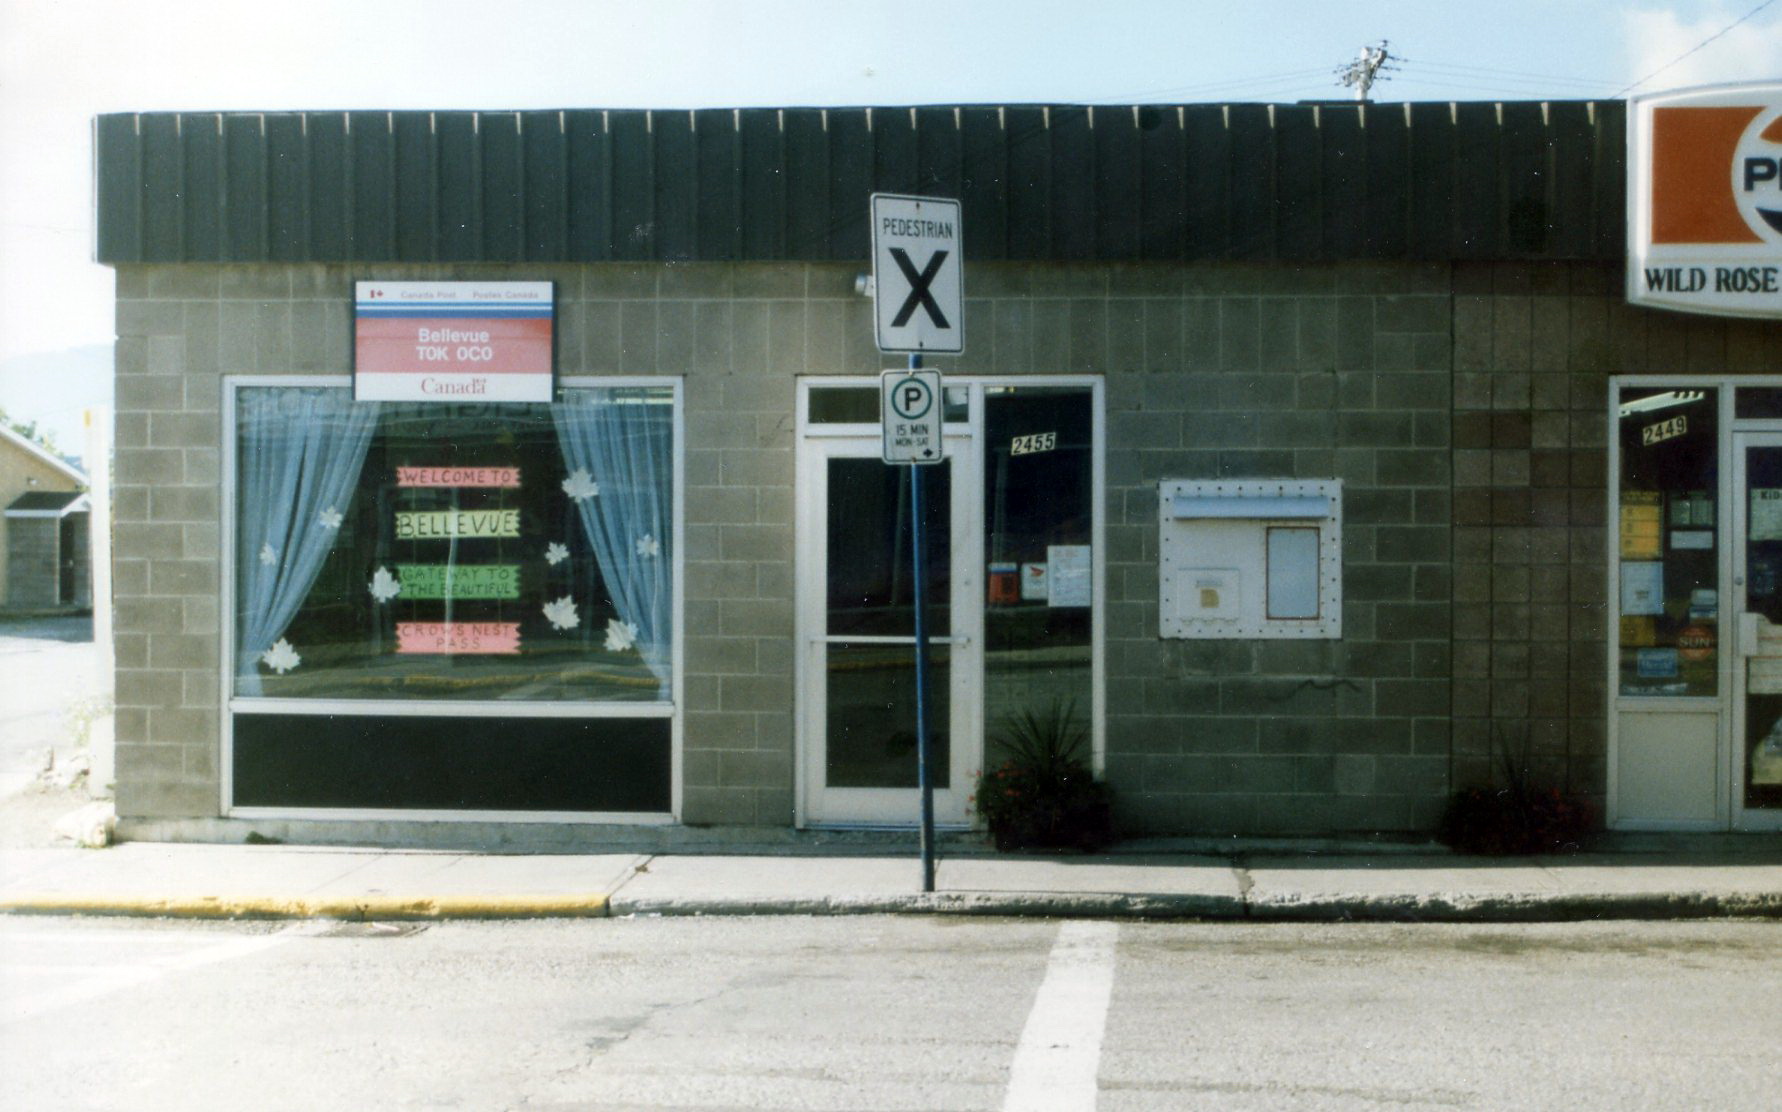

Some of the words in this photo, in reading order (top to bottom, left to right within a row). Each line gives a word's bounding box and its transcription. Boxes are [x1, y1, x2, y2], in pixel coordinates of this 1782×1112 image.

[1744, 157, 1782, 191] P
[883, 217, 953, 239] PEDESTRIAN
[888, 247, 951, 329] X
[1644, 267, 1706, 293] WILD
[1715, 267, 1779, 293] ROSE
[400, 290, 434, 299] Canada
[437, 290, 456, 299] Post
[472, 290, 500, 299] Postes
[505, 290, 539, 299] Canada
[418, 327, 490, 343] Bellevue
[420, 377, 487, 395] Canada
[903, 387, 922, 411] P
[896, 424, 907, 436] 15
[910, 424, 928, 435] MIN
[1645, 416, 1686, 444] 2449
[1014, 434, 1054, 453] 2455
[404, 470, 485, 483] WELCOME
[492, 470, 512, 482] TO
[400, 512, 515, 536] BELLEVUE
[487, 568, 509, 580] TO
[409, 583, 434, 595] THE
[441, 583, 512, 595] BEAUTIFUL
[436, 638, 480, 649] PASS
[1679, 637, 1710, 648] SUN
